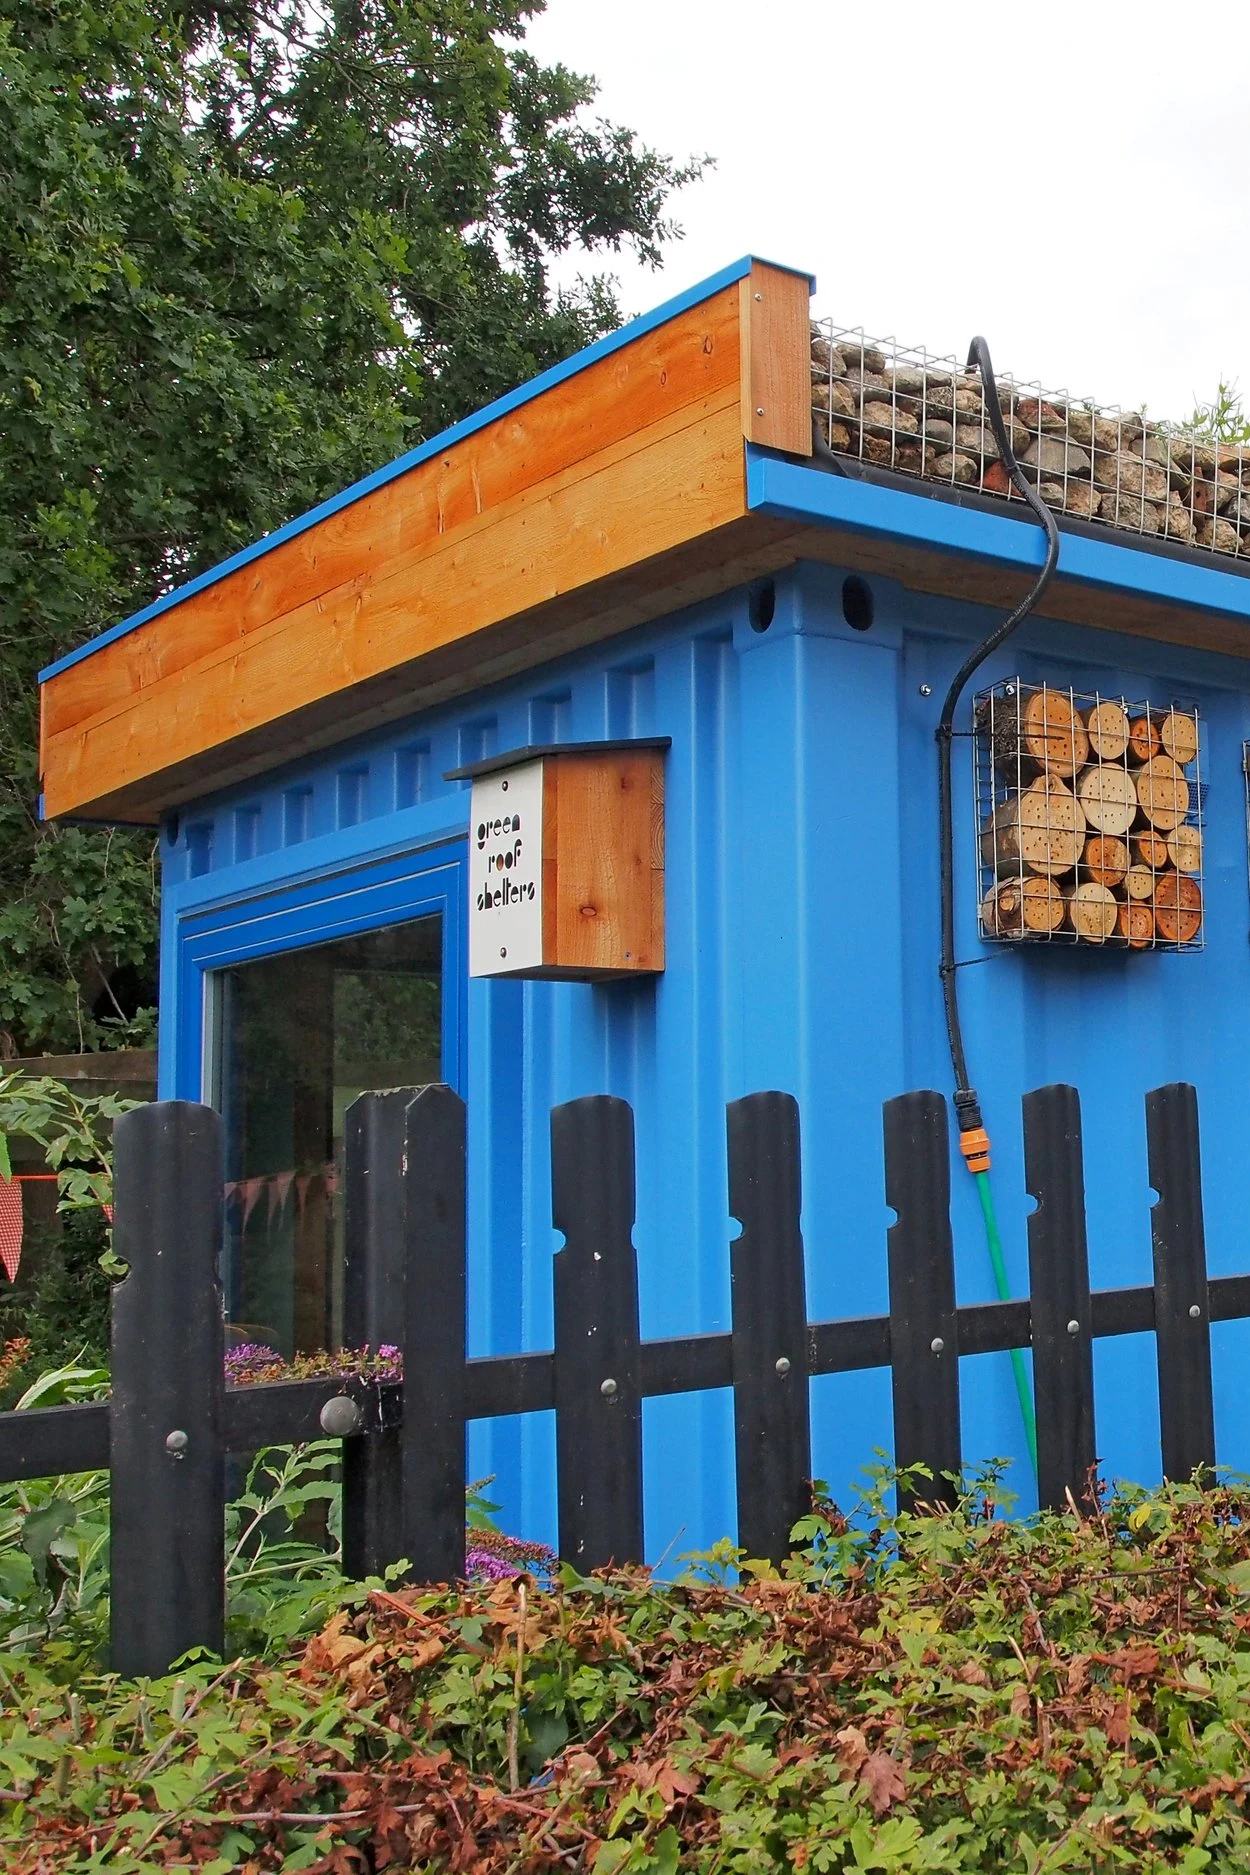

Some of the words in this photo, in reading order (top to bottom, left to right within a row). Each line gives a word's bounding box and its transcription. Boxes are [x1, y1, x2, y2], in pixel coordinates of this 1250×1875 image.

[477, 814, 520, 850] green
[488, 838, 522, 873] roof
[477, 877, 535, 911] shelters
